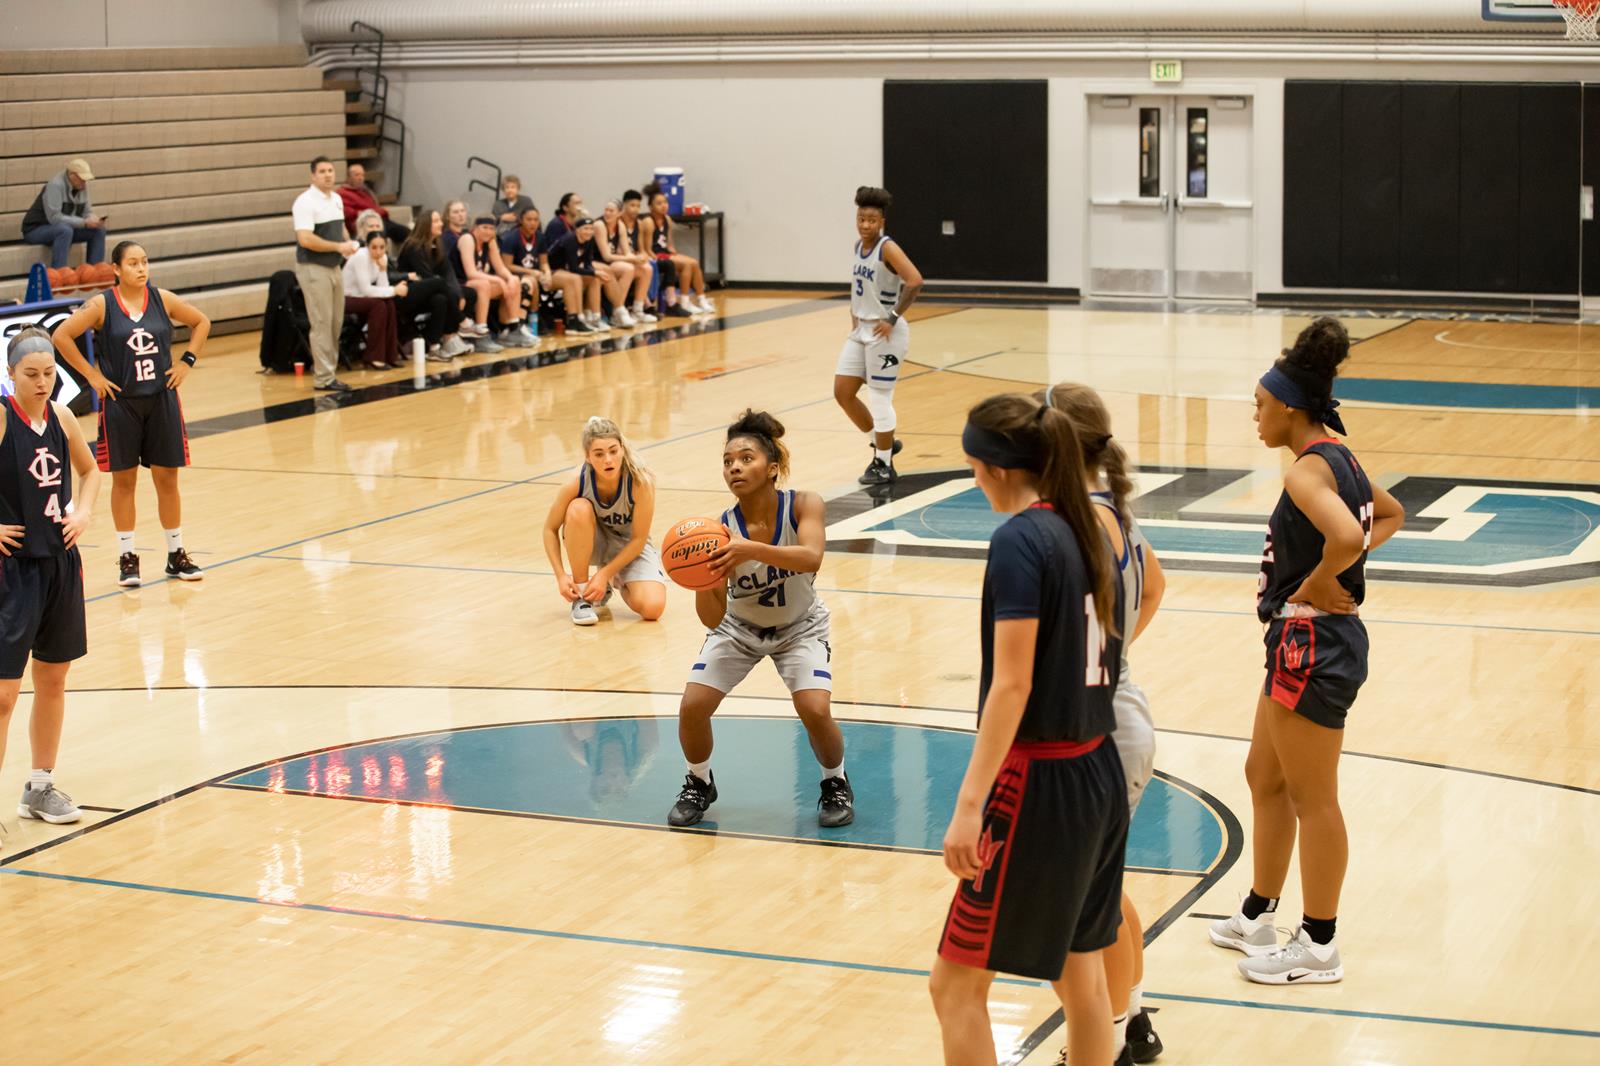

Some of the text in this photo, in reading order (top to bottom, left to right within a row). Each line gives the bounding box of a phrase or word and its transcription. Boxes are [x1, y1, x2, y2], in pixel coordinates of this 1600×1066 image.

[1155, 63, 1177, 79] EXIT
[853, 264, 875, 282] LARK
[856, 278, 864, 296] 3
[134, 358, 156, 382] 12
[43, 492, 63, 524] 4
[601, 512, 633, 525] ARK
[758, 583, 786, 608] 21
